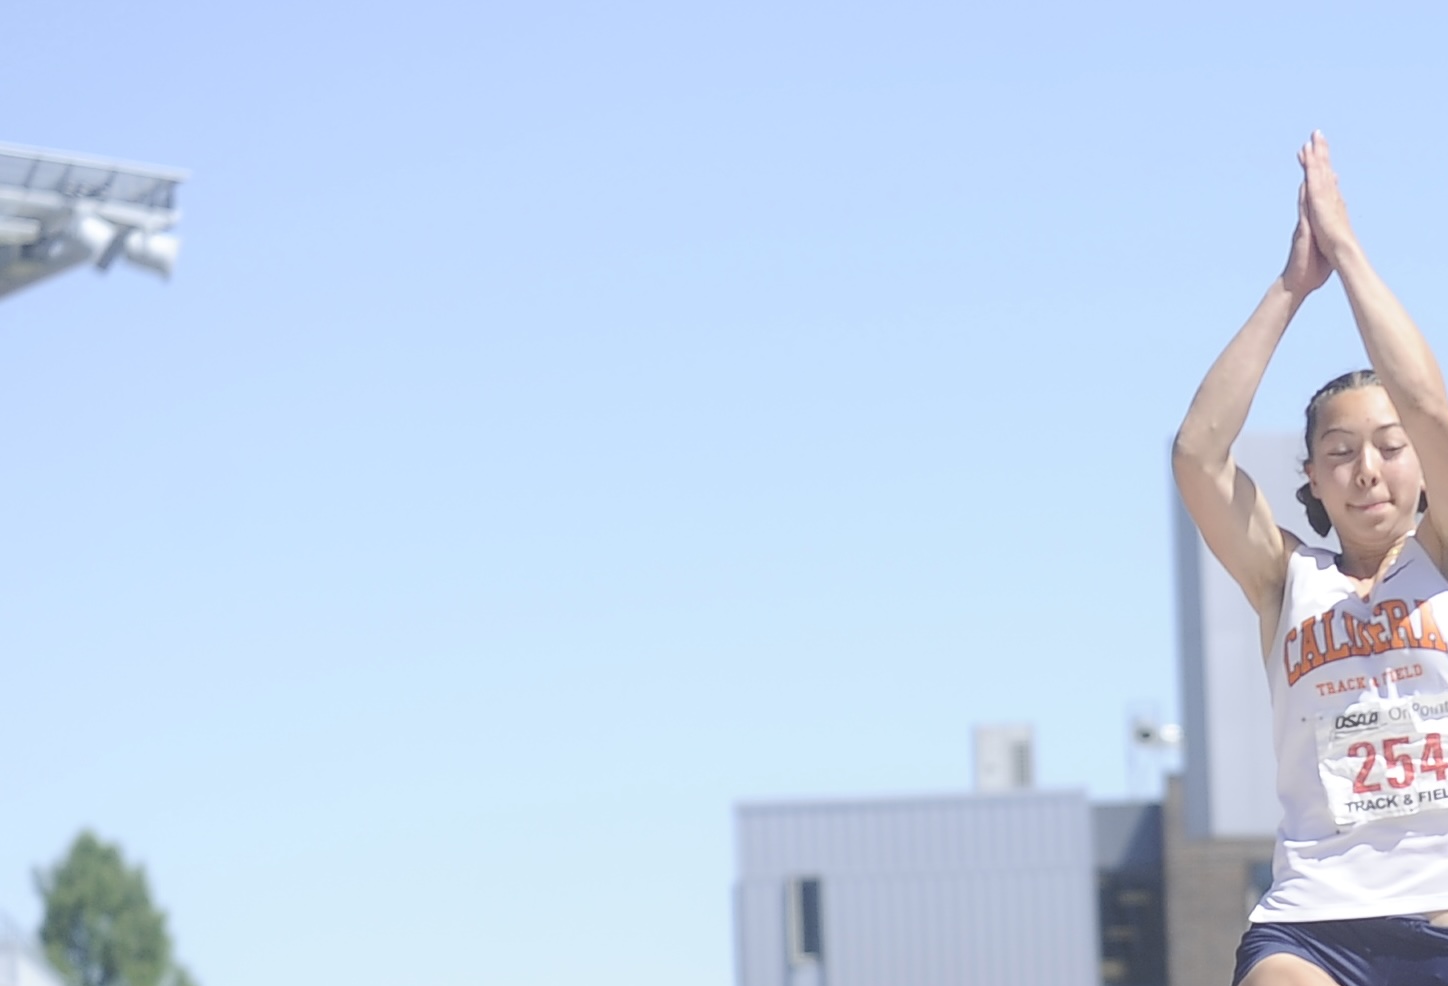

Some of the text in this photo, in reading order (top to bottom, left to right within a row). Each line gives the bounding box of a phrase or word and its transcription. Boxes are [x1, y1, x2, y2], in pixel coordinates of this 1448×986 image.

[1316, 677, 1366, 697] TRACK
[1344, 794, 1399, 814] TRACK
[1403, 793, 1413, 806] &
